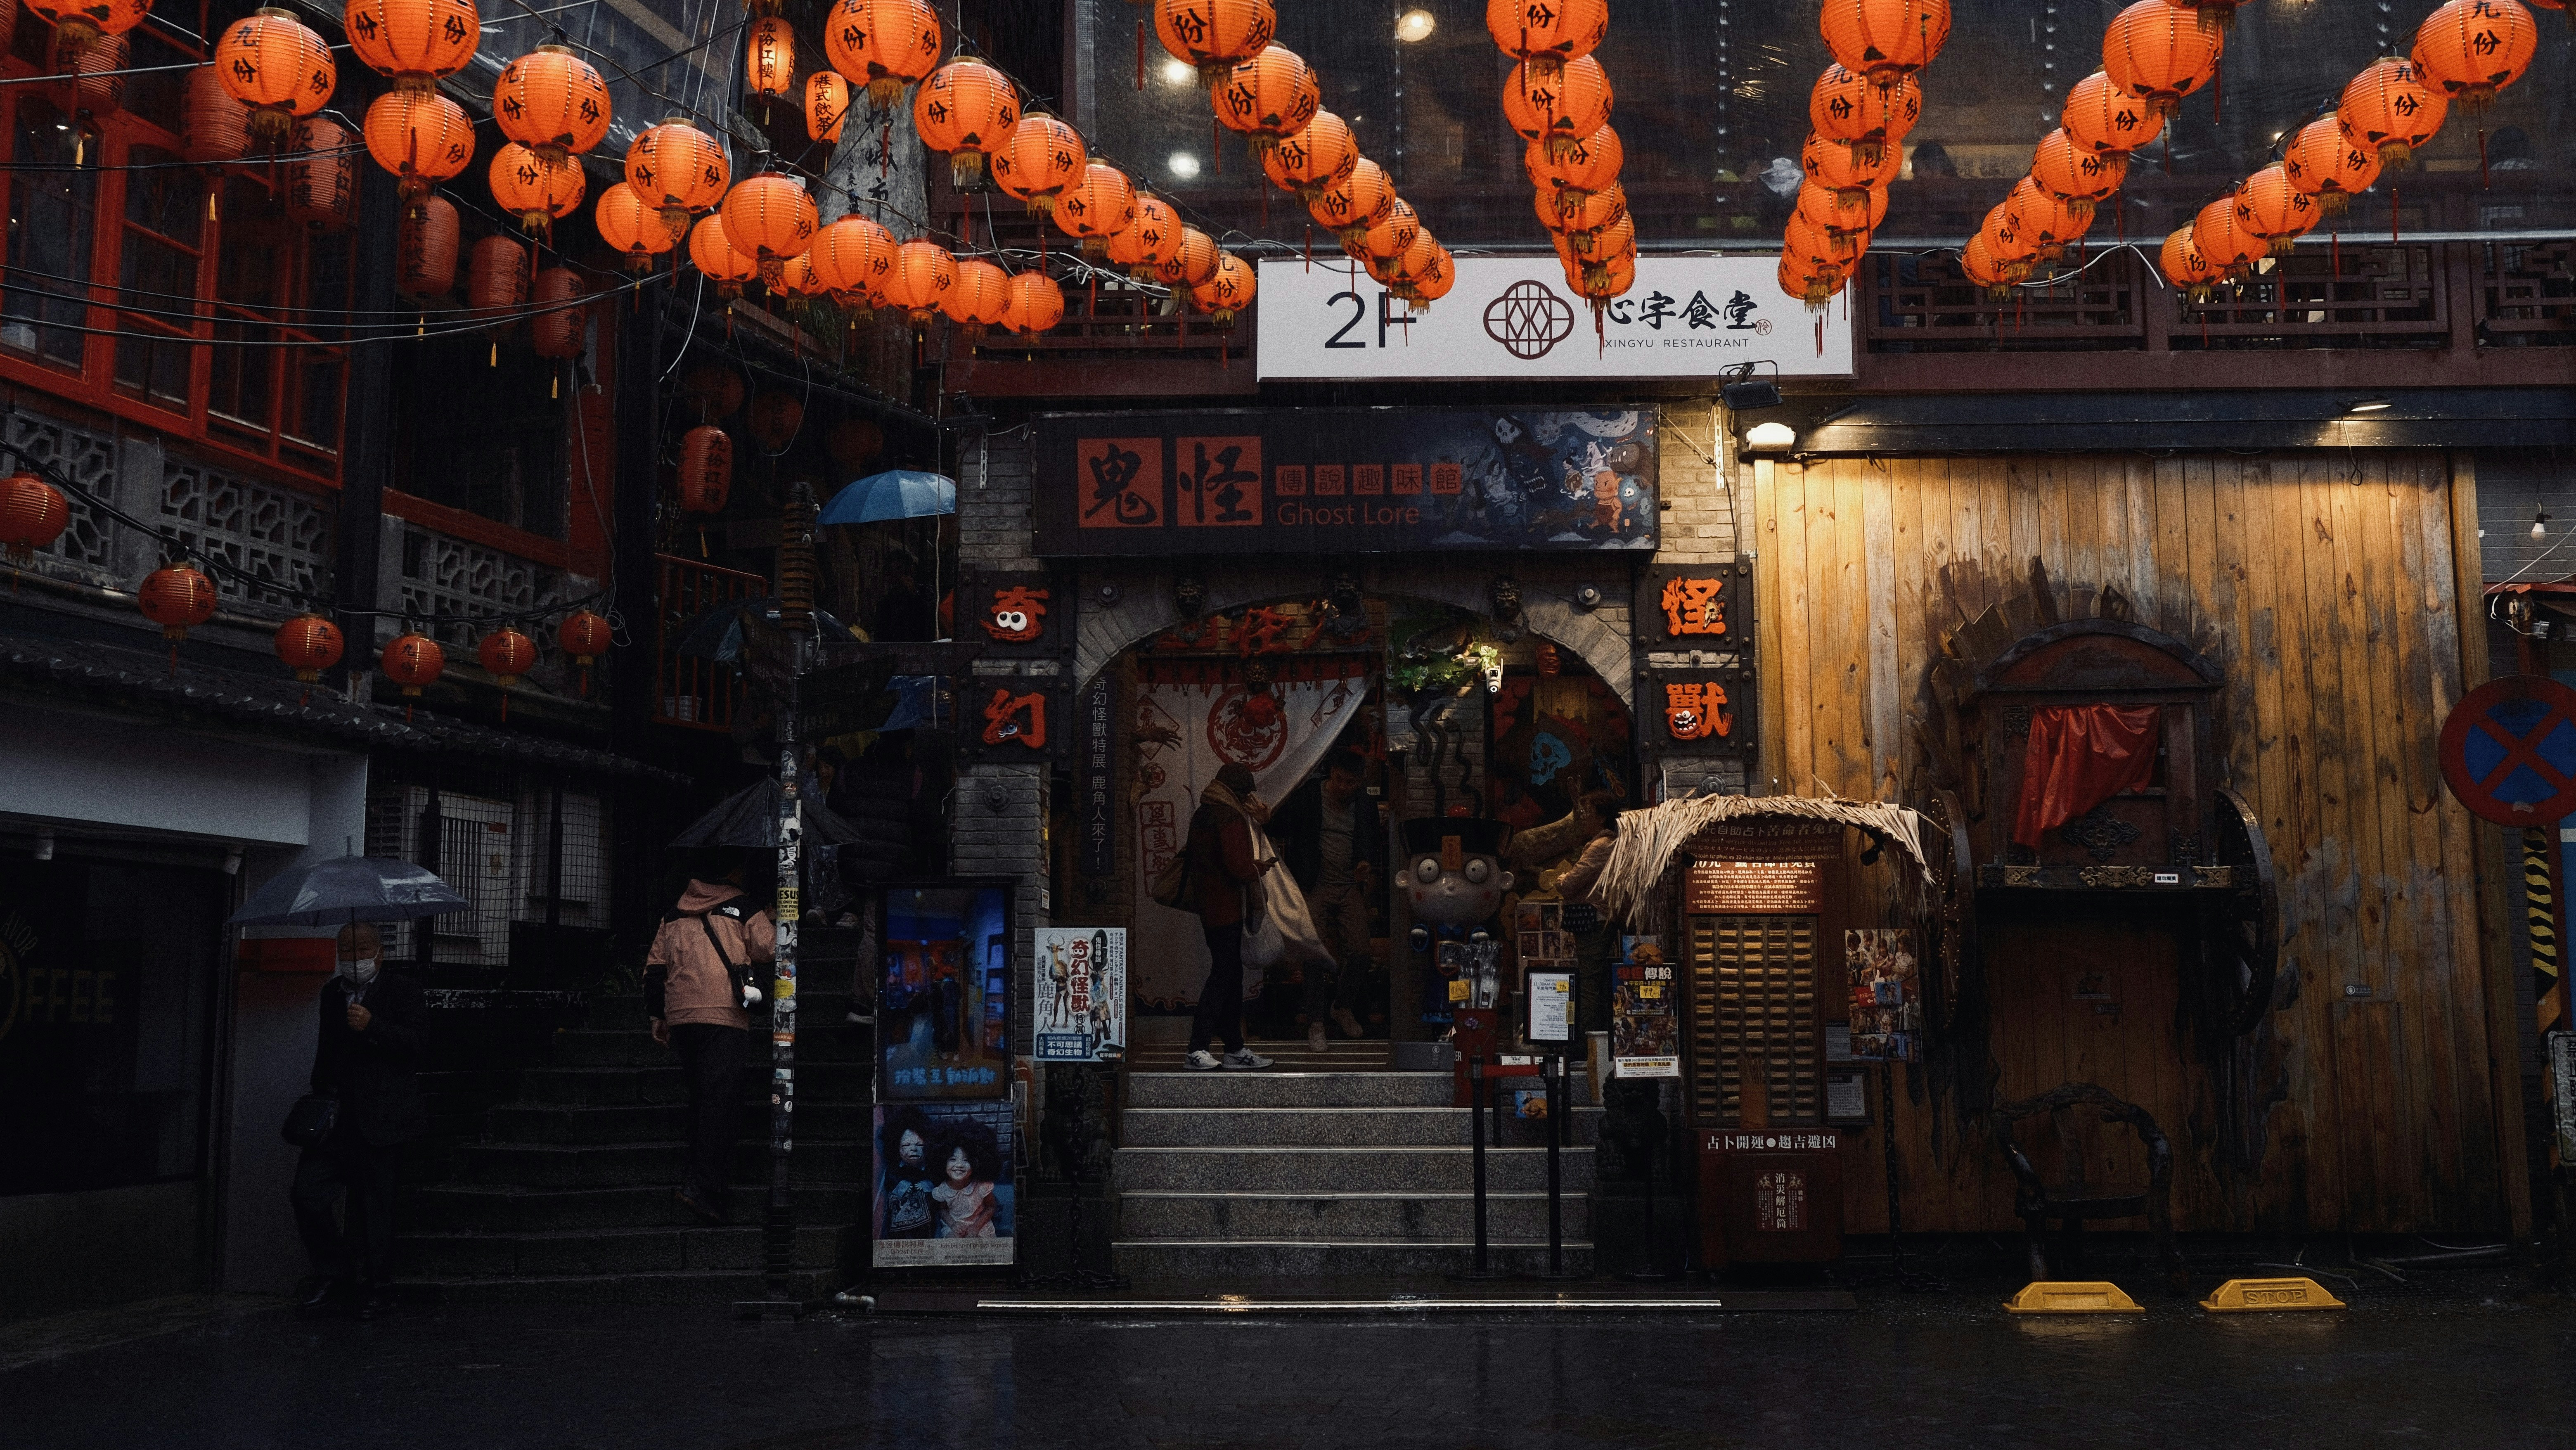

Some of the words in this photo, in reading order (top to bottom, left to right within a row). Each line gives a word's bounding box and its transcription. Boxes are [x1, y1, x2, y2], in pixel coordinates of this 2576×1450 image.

[1175, 9, 1207, 43] 份
[1527, 4, 1554, 28] 份
[2474, 1, 2501, 54] 九份
[234, 27, 256, 83] 九份
[504, 65, 521, 119] 九份
[581, 70, 601, 124] 九份
[814, 75, 833, 132] 港式飲茶
[929, 73, 947, 123] 九份
[1830, 69, 1853, 119] 九份
[2395, 66, 2419, 116] 九份
[636, 136, 653, 186] 九份
[703, 138, 723, 187] 九份
[1055, 126, 1073, 172] 九份
[1281, 141, 1306, 170] 份
[1143, 206, 1160, 246] 九份
[1326, 191, 1350, 216] 份
[1325, 291, 1417, 349] 2F
[1607, 290, 1758, 330] 心宇食堂
[1605, 339, 1653, 348] XINGYU
[1664, 339, 1749, 348] RESTAURANT
[1084, 442, 1259, 525] 鬼怪
[1280, 468, 1458, 492] 傳說趣味館
[1278, 501, 1355, 527] Ghost
[1364, 501, 1419, 525] Lore
[1092, 677, 1108, 769] 奇幻怪獸特展
[1071, 940, 1090, 1012] 奇幻怪獸
[1037, 983, 1054, 1033] 鹿角人
[1075, 1013, 1085, 1034] 特展
[1775, 1173, 1786, 1229] 消災解厄筒
[2246, 1291, 2304, 1305] STOP
